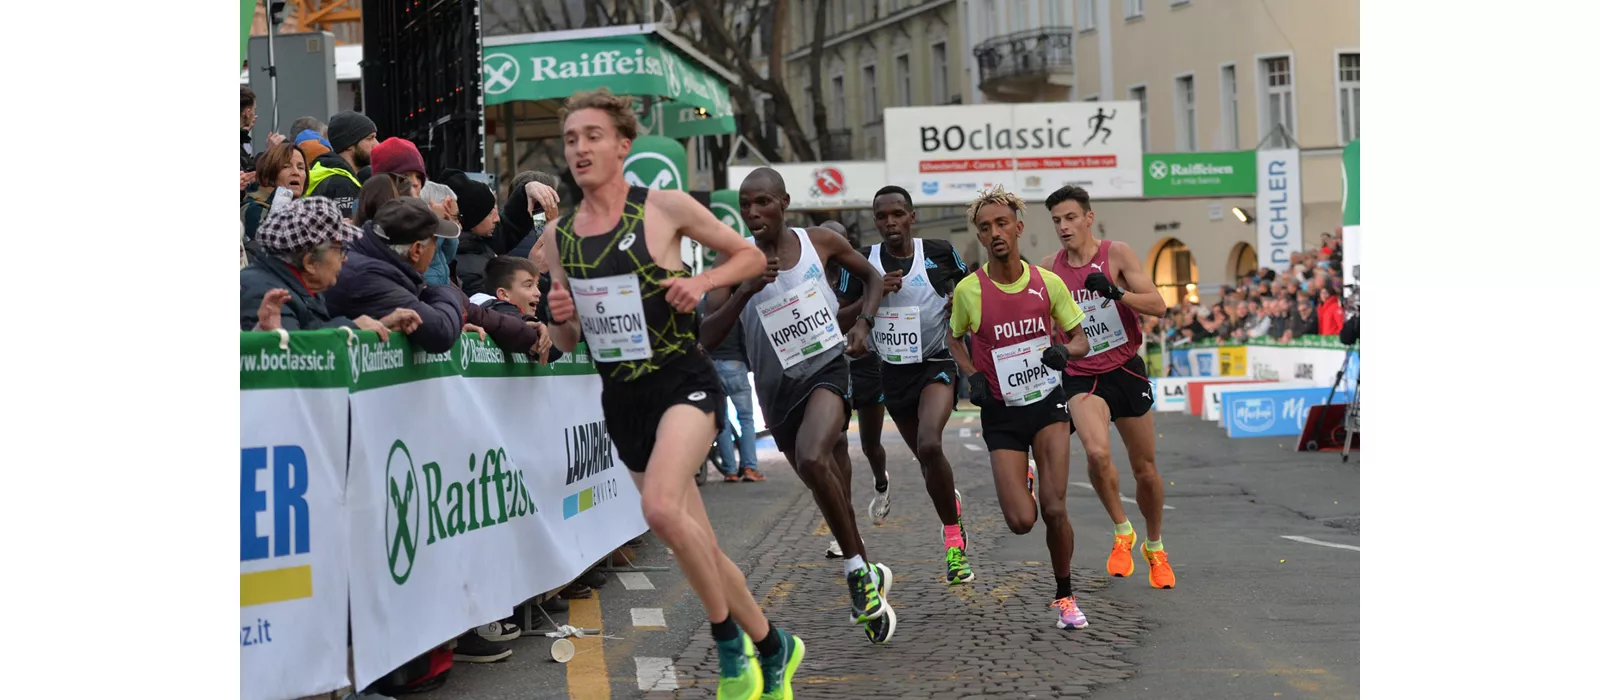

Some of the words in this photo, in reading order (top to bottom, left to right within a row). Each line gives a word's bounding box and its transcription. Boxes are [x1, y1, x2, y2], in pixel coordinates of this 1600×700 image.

[530, 48, 664, 82] Raiffeis
[920, 118, 1072, 152] BOclassic
[1171, 163, 1234, 175] Raiffeisen
[1268, 160, 1289, 264] PICHLER
[596, 302, 605, 314] 6
[1071, 289, 1100, 304] LIZIA
[580, 312, 642, 335] HAUMETON
[791, 308, 801, 320] 5
[1088, 315, 1095, 323] 4
[771, 307, 832, 347] KIPROTICH
[874, 330, 918, 346] KIPRUTO
[888, 322, 895, 332] 2
[994, 316, 1046, 341] POLIZIA
[1083, 322, 1109, 339] RIVA
[362, 341, 404, 373] Raiffeisen
[1023, 358, 1028, 368] 1
[1007, 364, 1049, 388] CRIPPA
[1164, 385, 1184, 396] LA
[240, 444, 310, 562] ER
[422, 446, 538, 546] Raiffeis
[240, 618, 272, 647] z.it
